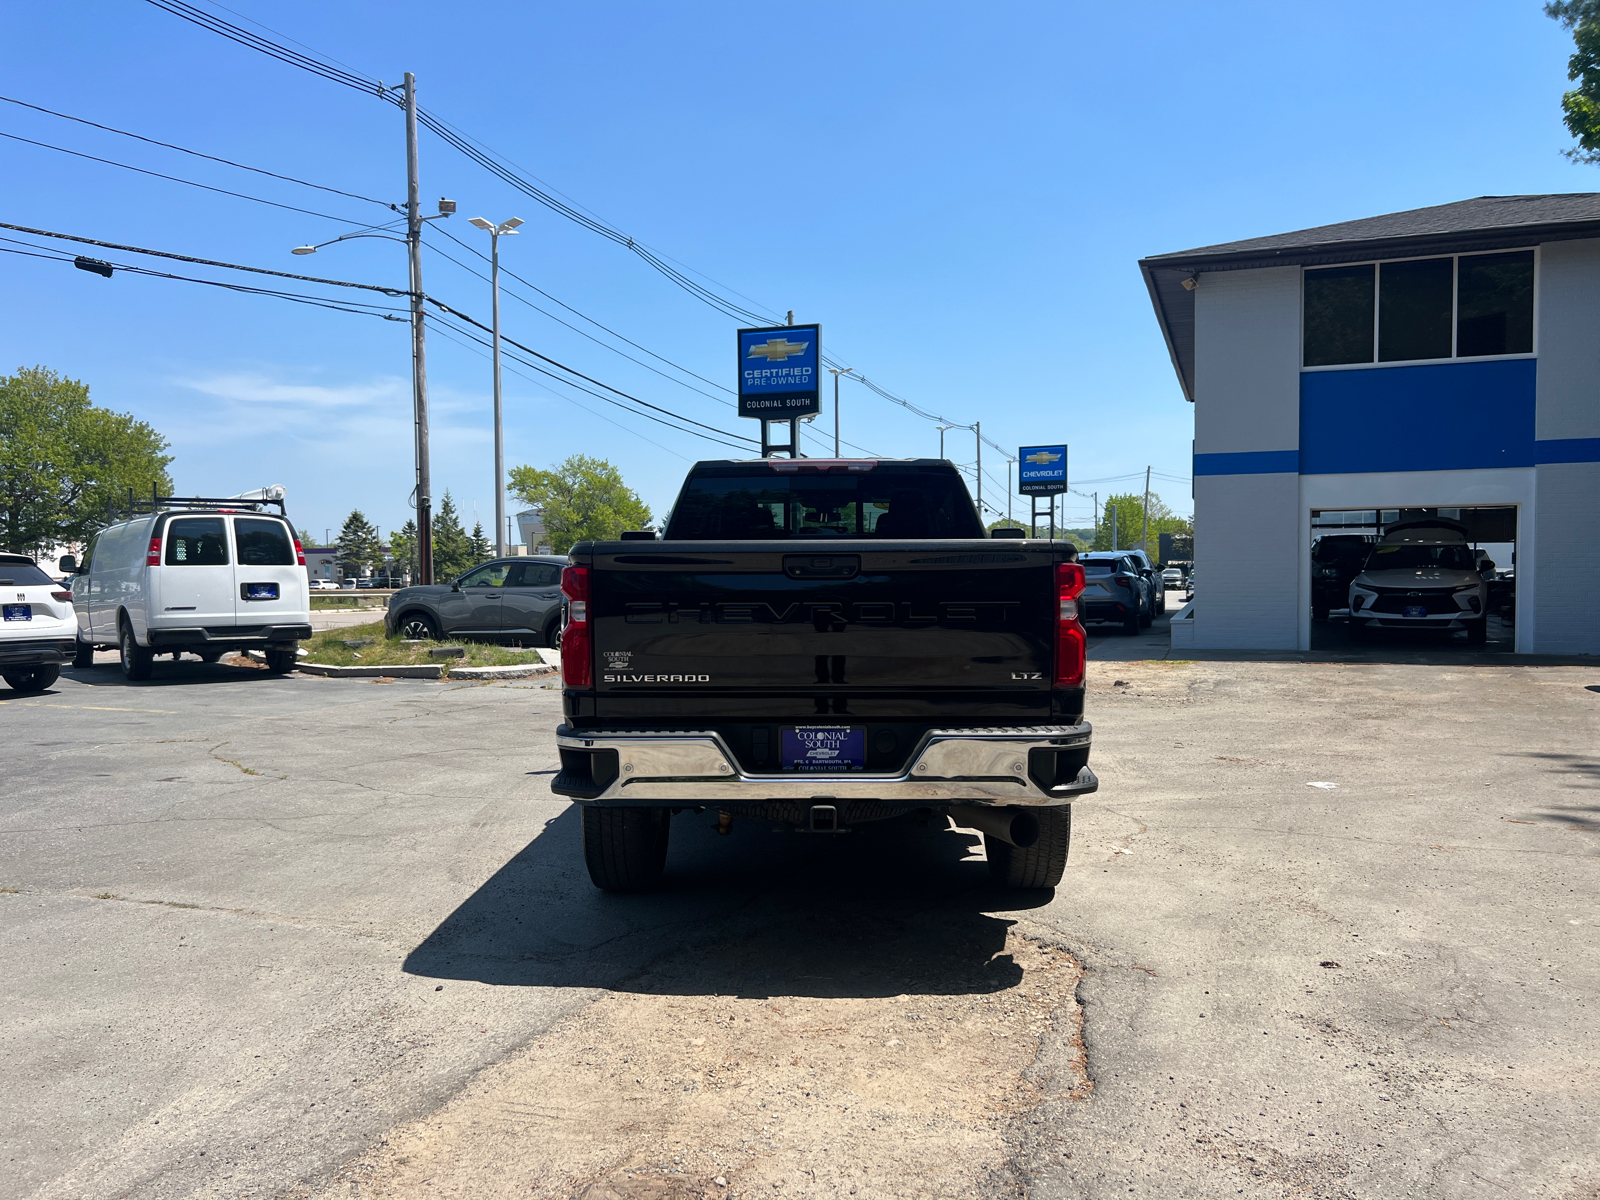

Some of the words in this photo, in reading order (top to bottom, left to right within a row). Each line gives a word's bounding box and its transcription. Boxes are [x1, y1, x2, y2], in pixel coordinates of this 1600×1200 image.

[744, 367, 812, 378] CERTIFIED
[748, 376, 808, 386] PRE-OWNED
[746, 400, 782, 408] COLONIAL
[624, 601, 1021, 625] CHEVROLET
[798, 732, 848, 740] COLONIAL
